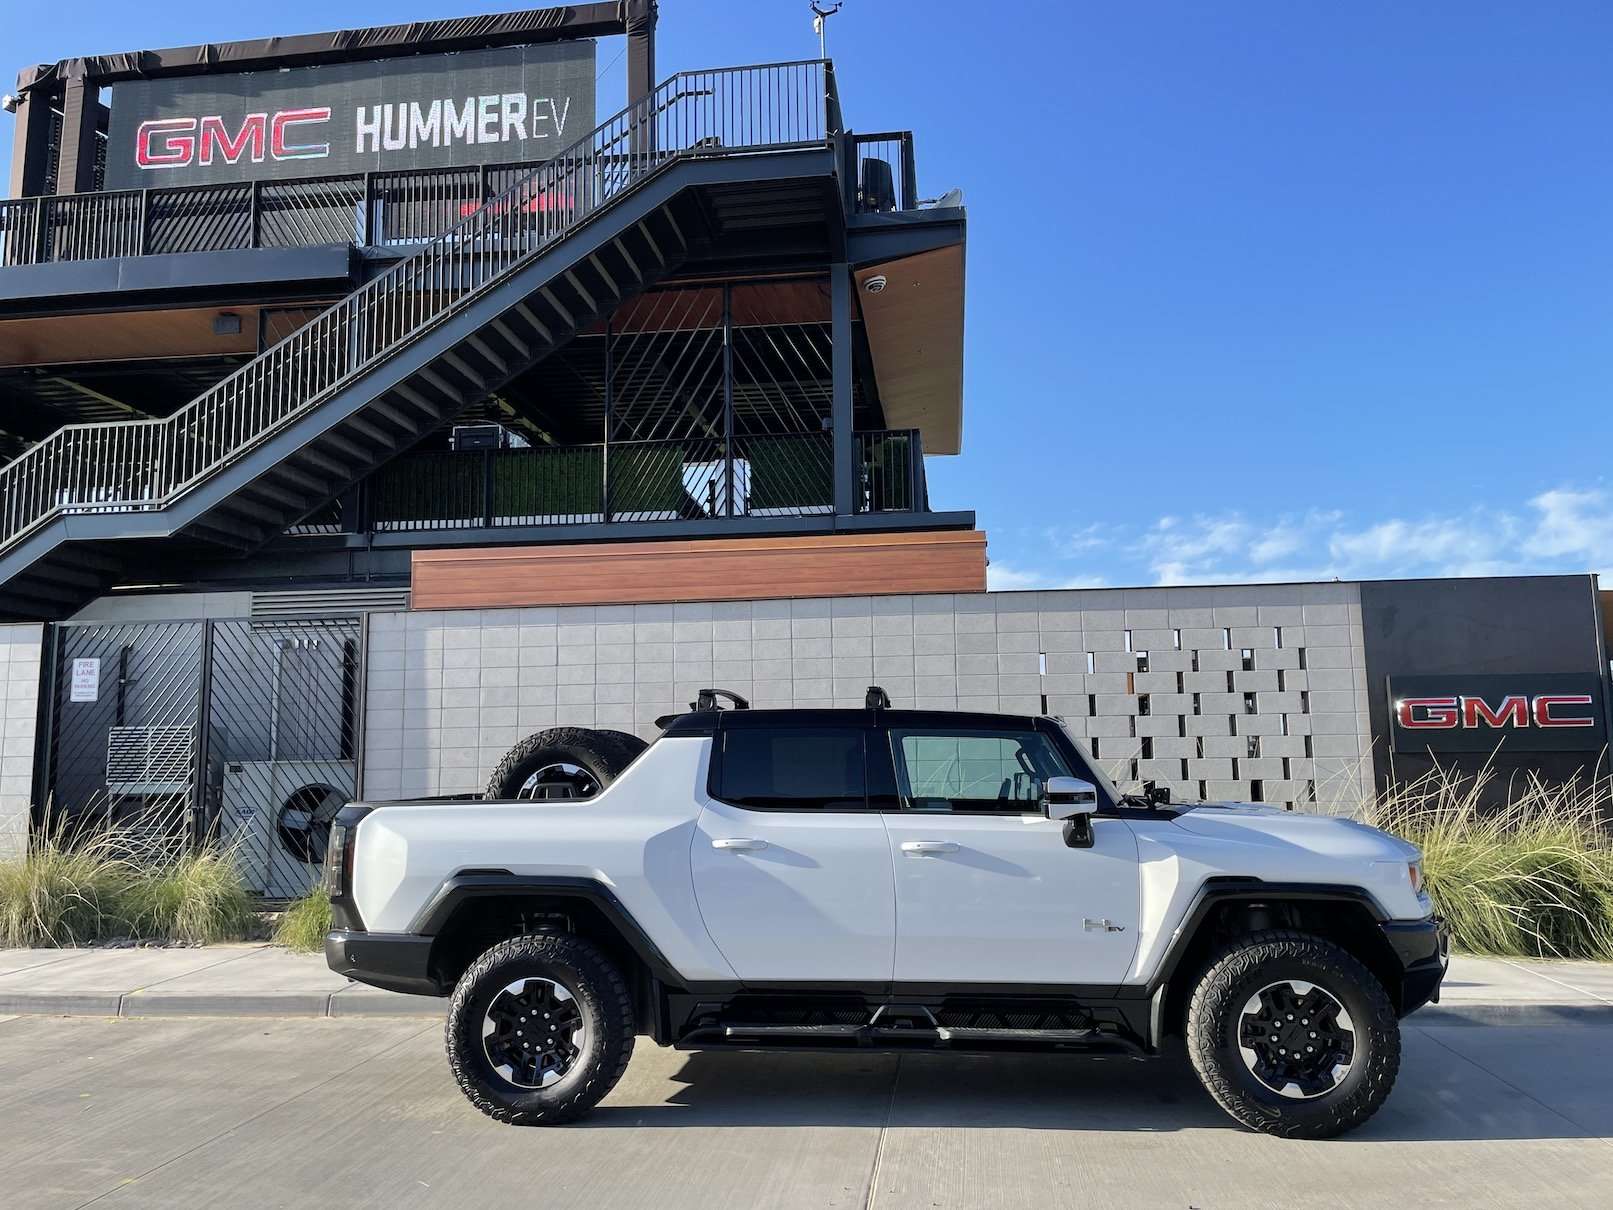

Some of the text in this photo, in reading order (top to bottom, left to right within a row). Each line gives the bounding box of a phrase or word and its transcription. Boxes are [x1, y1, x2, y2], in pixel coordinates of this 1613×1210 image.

[135, 106, 331, 170] GMC
[356, 92, 571, 154] HUMMER EV
[1396, 695, 1595, 729] GMC
